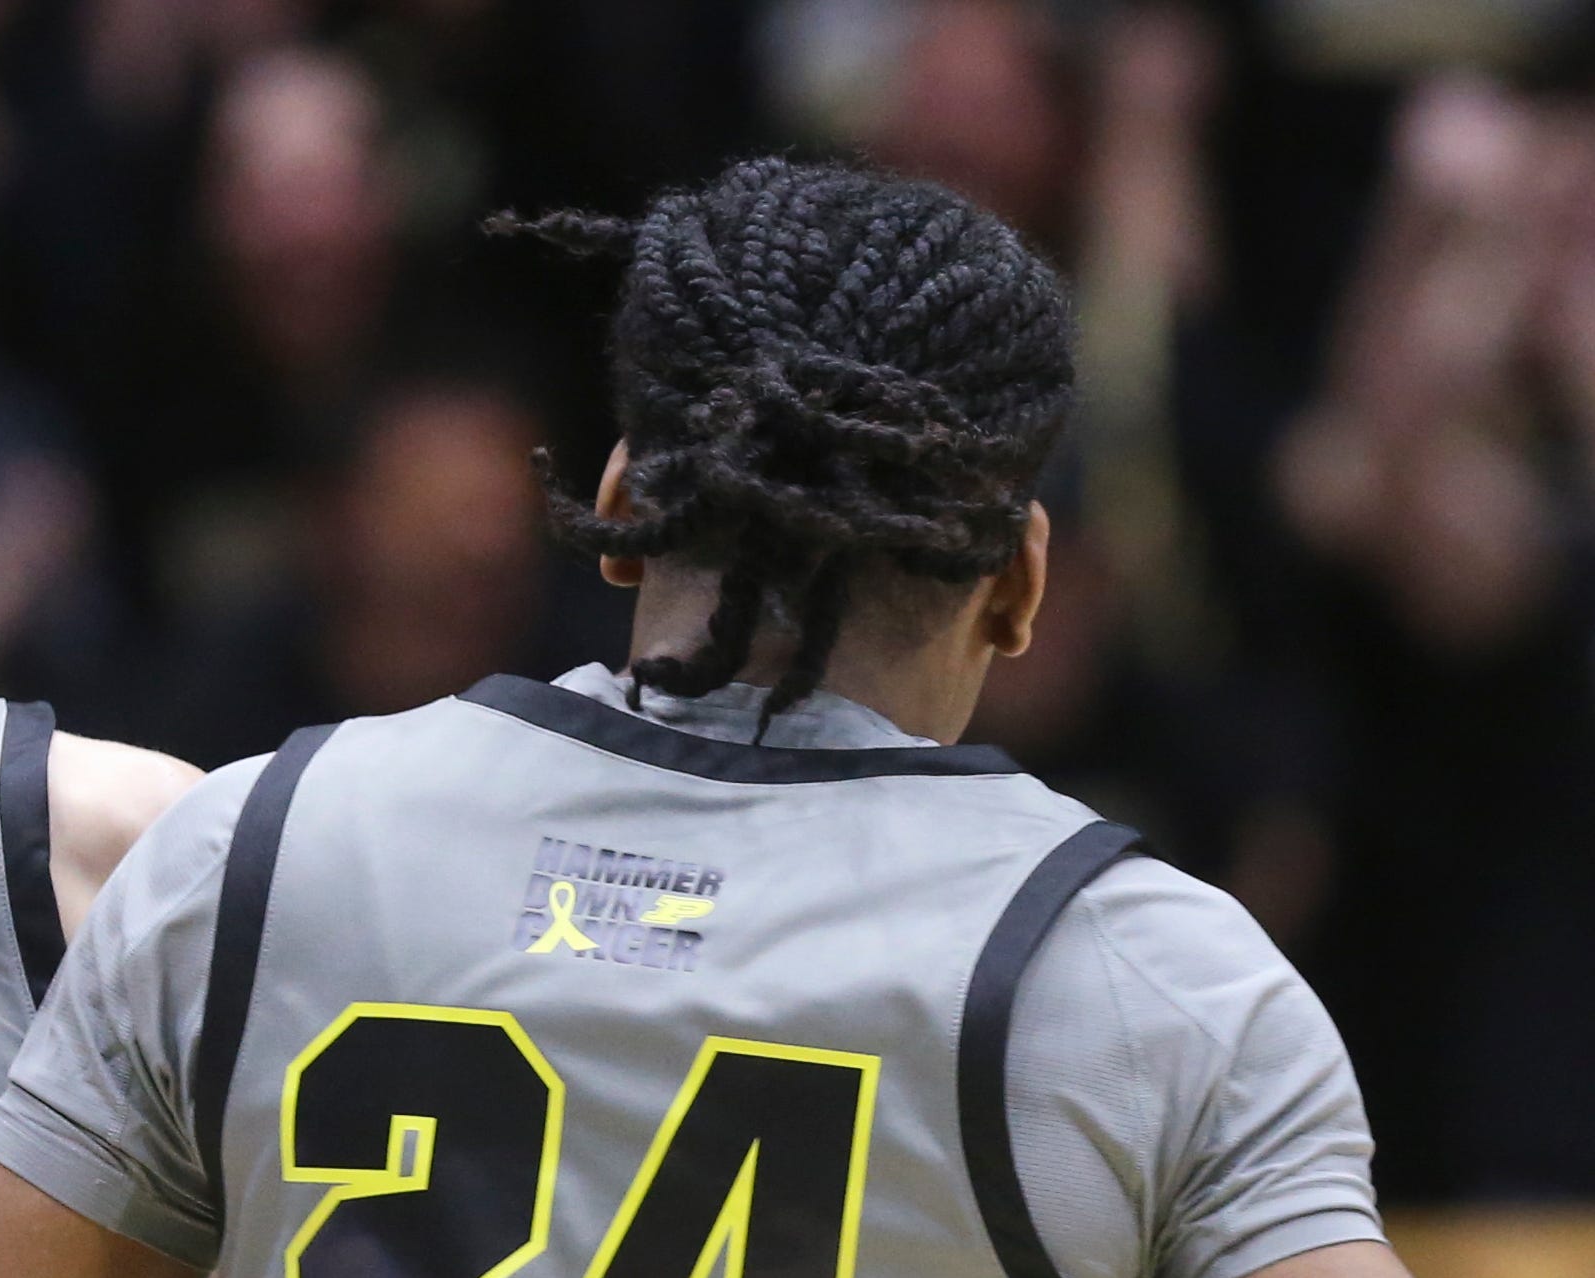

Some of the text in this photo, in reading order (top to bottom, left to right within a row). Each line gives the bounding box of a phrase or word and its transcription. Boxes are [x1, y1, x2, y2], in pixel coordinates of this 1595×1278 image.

[523, 873, 638, 922] DWN
[532, 836, 727, 898] HAMMER
[513, 911, 704, 973] CNCER
